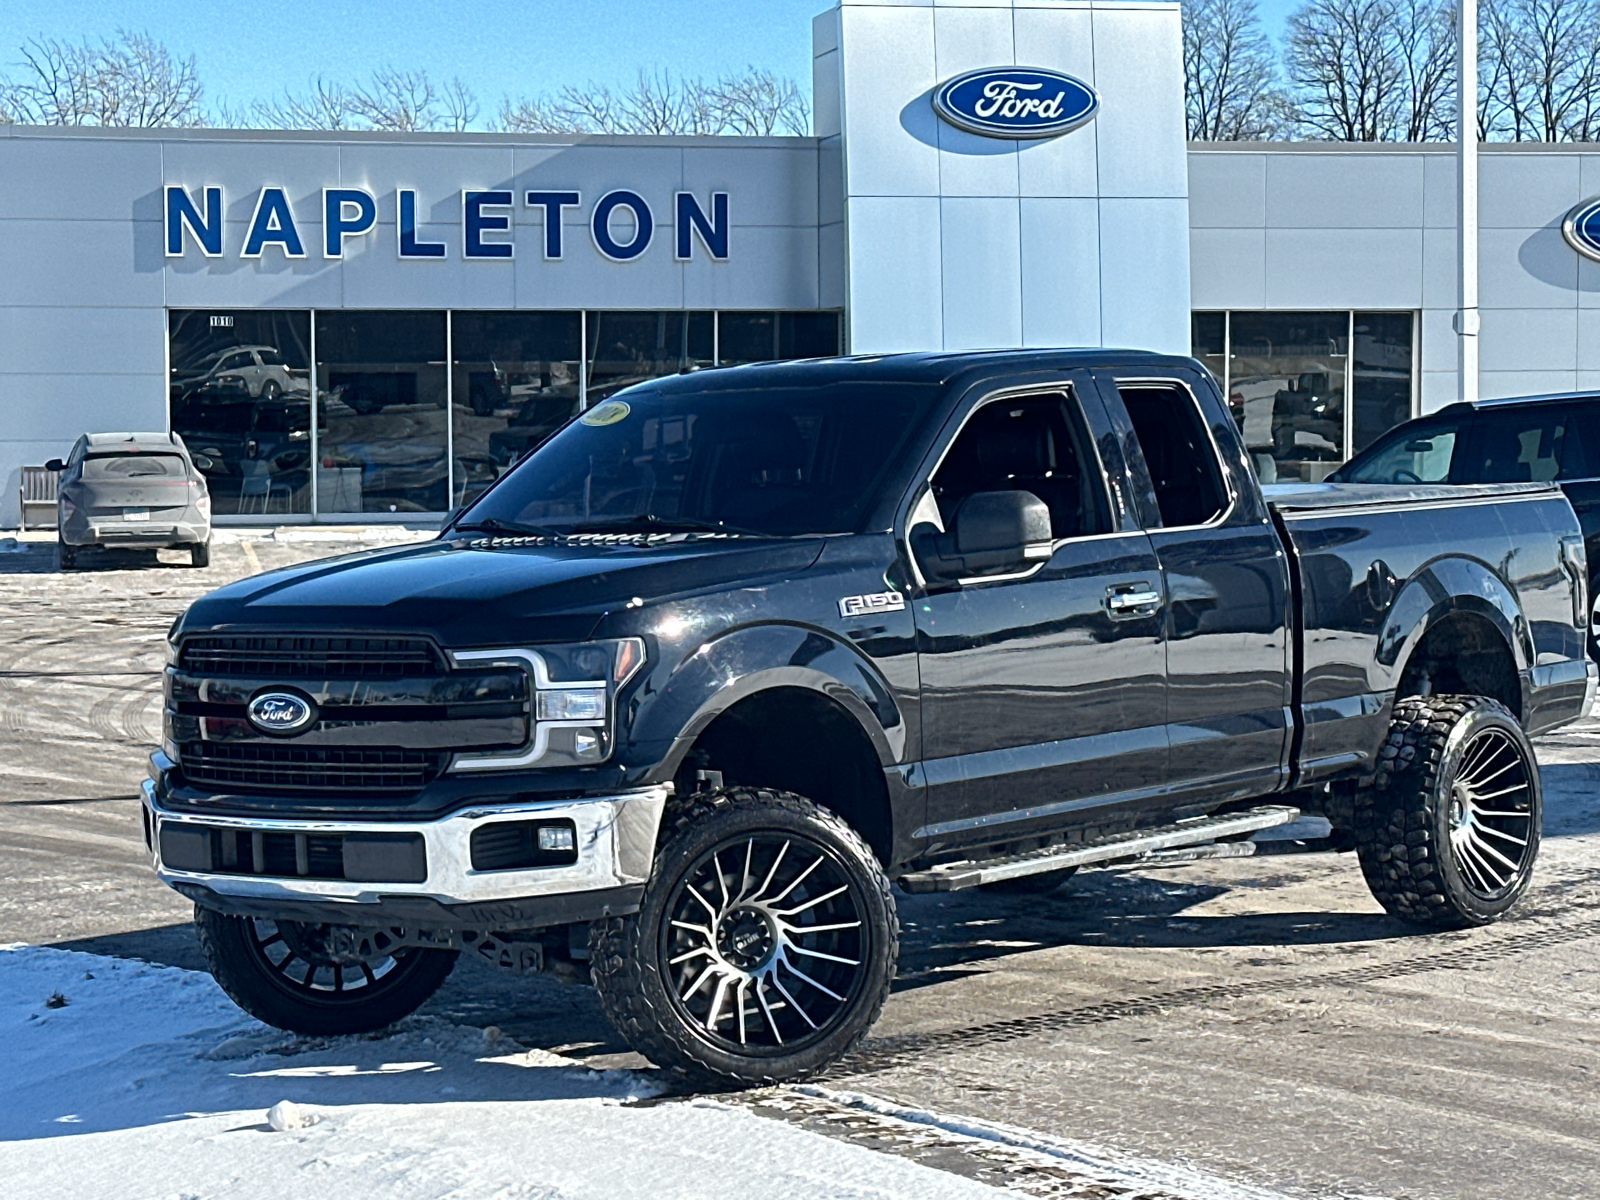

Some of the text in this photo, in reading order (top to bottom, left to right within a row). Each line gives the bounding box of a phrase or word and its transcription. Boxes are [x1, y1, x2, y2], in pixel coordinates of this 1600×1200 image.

[974, 80, 1066, 118] Ford
[164, 185, 730, 262] NAPLETON
[210, 315, 234, 327] 1010
[260, 700, 294, 721] Ford
